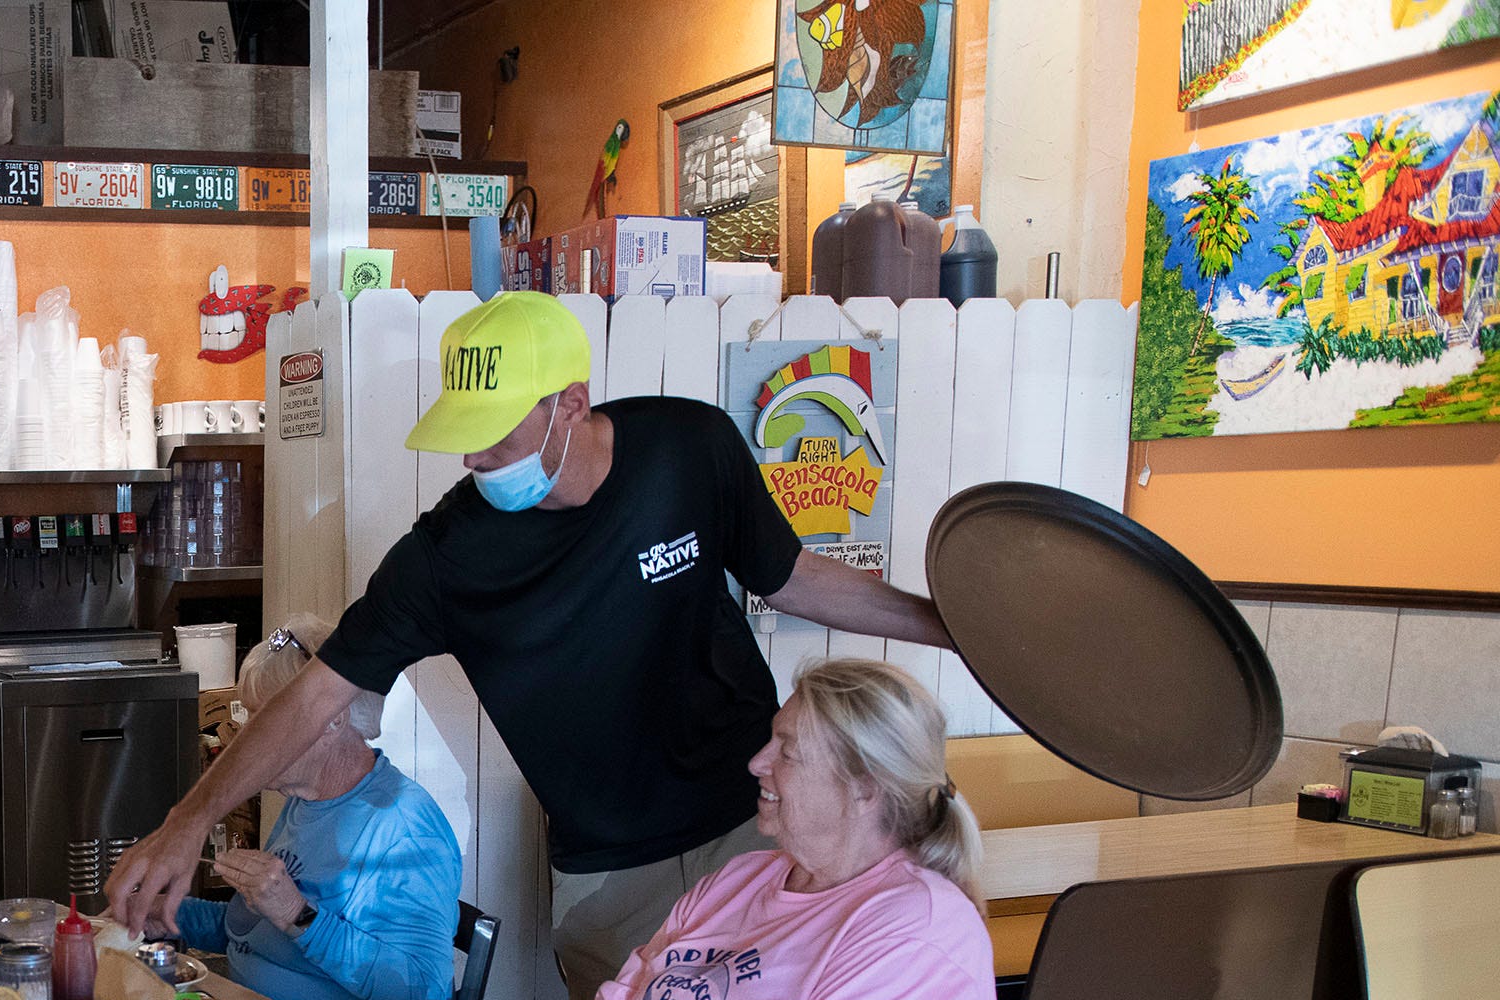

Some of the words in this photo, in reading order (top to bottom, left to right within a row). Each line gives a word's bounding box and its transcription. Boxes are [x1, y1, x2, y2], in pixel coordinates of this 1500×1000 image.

[130, 27, 141, 58] CALIENT
[146, 32, 156, 53] COLD
[75, 165, 104, 173] SUNSHINE
[171, 167, 200, 176] SUNSHINE
[202, 168, 219, 176] STATE
[9, 171, 40, 196] 215
[60, 172, 79, 196] 9V
[100, 173, 138, 198] 2604
[156, 174, 176, 198] 9W
[195, 176, 234, 201] 9818
[252, 178, 270, 202] 9W
[445, 176, 489, 185] FLORIDA
[75, 198, 124, 207] FLORIDA
[171, 200, 219, 209] FLORIDA
[379, 183, 416, 207] 2869
[467, 185, 503, 208] 3540
[369, 206, 401, 215] ORIDA
[284, 357, 318, 379] WARNING
[283, 400, 302, 411] CHILDREN
[804, 439, 837, 452] TURN
[800, 451, 837, 464] RIGHT
[769, 463, 878, 498] Pensacola
[781, 485, 850, 518] Beach
[649, 542, 668, 562] go
[826, 546, 845, 554] DRIVE
[846, 544, 861, 553] EAST
[862, 543, 882, 551] ALONG
[640, 539, 700, 580] NATIVE
